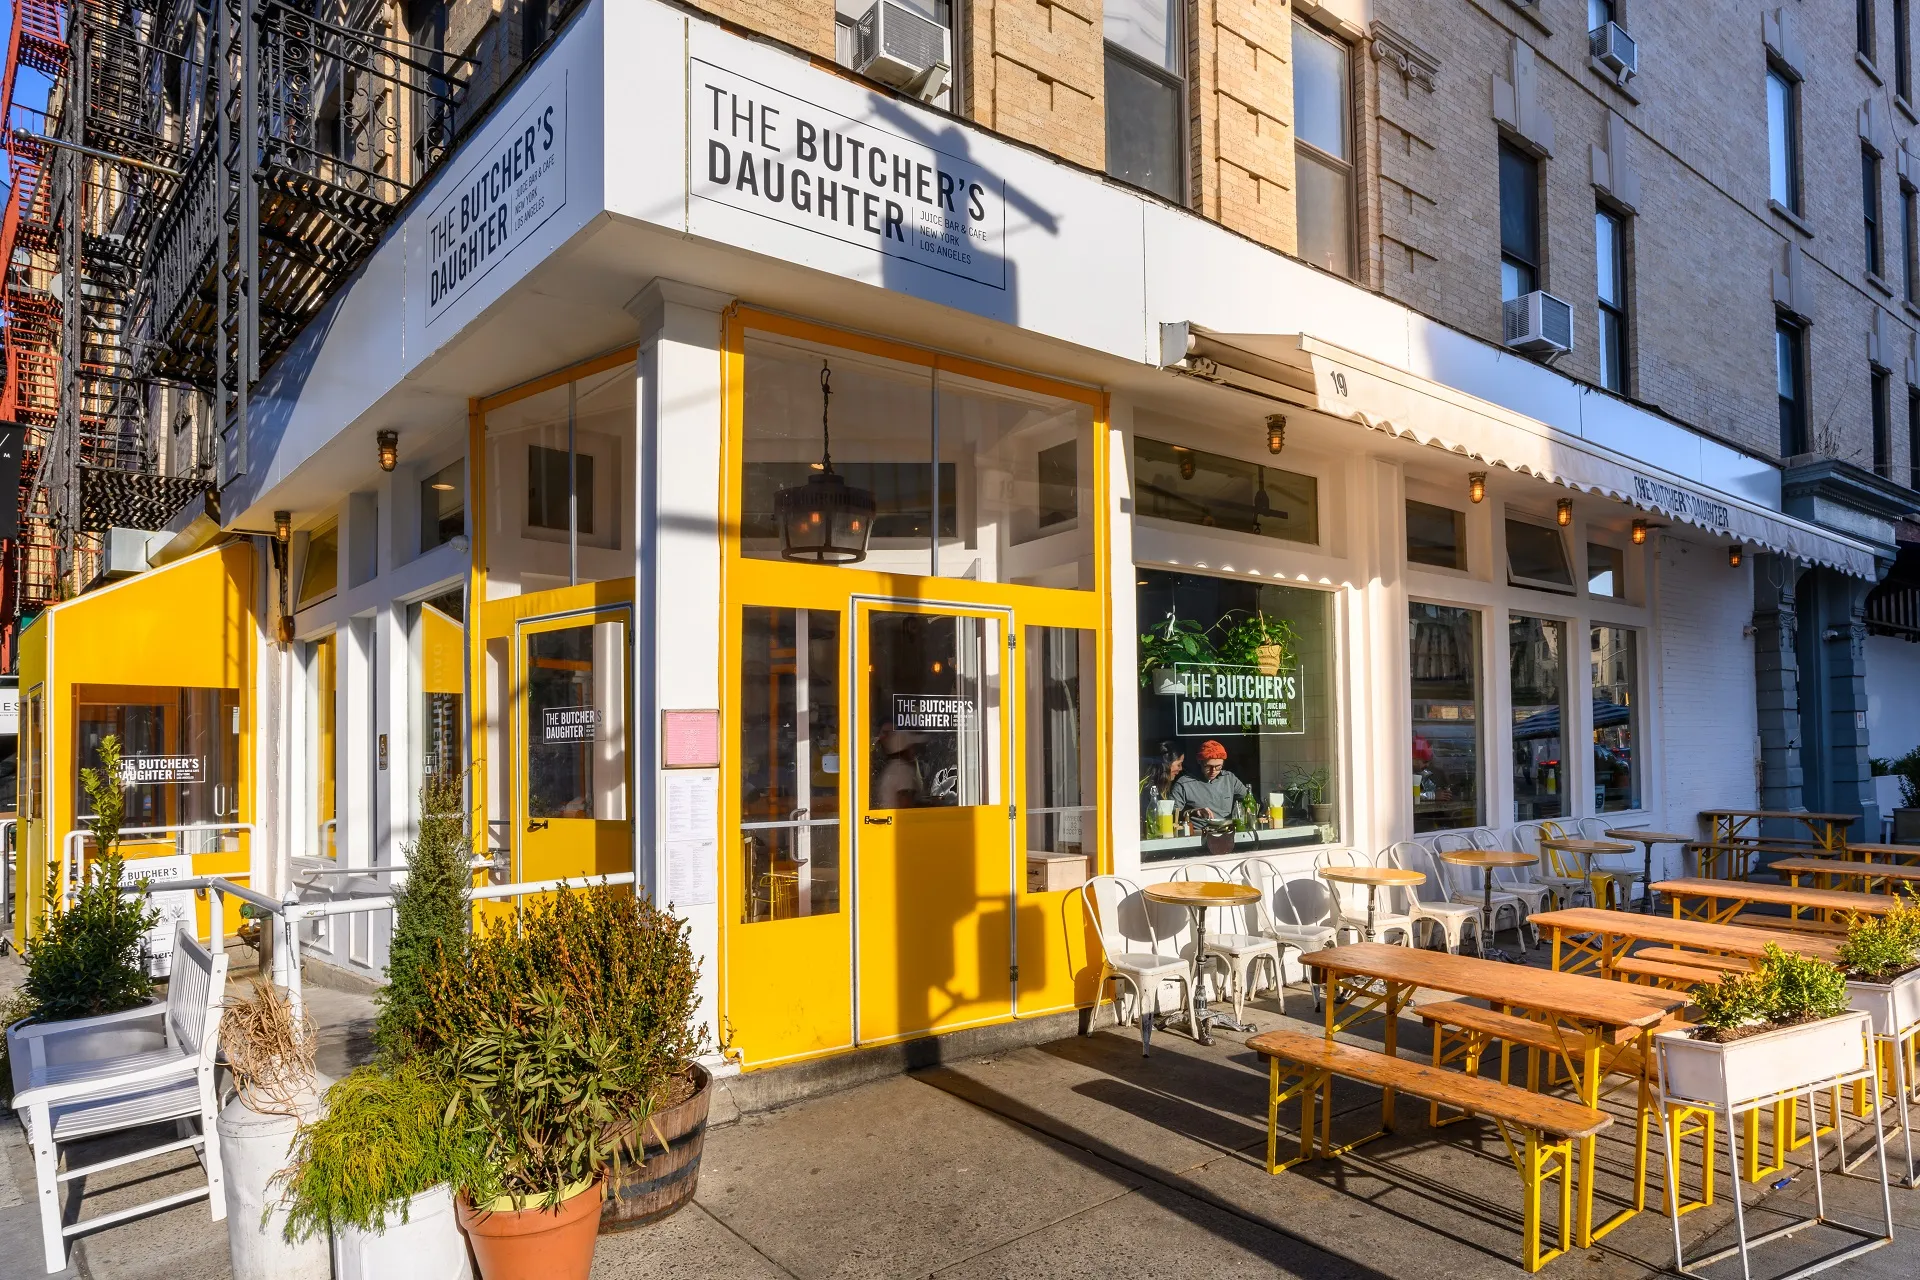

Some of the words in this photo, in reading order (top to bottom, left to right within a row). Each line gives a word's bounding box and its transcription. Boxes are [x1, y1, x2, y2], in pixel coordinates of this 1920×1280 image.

[705, 83, 780, 152] THE
[796, 118, 986, 222] BUTCHER'S
[430, 205, 456, 263] THE
[461, 105, 554, 235] BUTCHER'S
[515, 180, 528, 200] JUICE
[528, 170, 538, 187] BAR
[542, 153, 555, 173] CAFE
[515, 198, 526, 216] NEW
[526, 186, 538, 205] YORK
[708, 138, 905, 243] DAUGHTER
[515, 215, 524, 232] LOS
[523, 196, 545, 224] ANGELES
[920, 210, 943, 226] JUICE
[944, 218, 960, 232] BAR
[960, 224, 967, 234] &
[968, 226, 987, 241] CAFE
[920, 225, 938, 239] NEW
[939, 232, 960, 247] YORK
[431, 202, 508, 308] DAUGHTER
[920, 239, 935, 253] LOS
[936, 245, 972, 265] ANGELES
[1330, 370, 1348, 398] 19
[1633, 475, 1653, 500] THE
[1650, 481, 1692, 513] BUTCHER'S
[1691, 496, 1729, 528] DAUGHTER
[1181, 673, 1212, 698] THE
[1216, 674, 1296, 700] BUTCHER'S
[545, 712, 560, 726] THE
[560, 709, 602, 725] BUTCHERS
[897, 699, 917, 713] THE
[920, 699, 974, 714] BUTCHER'S
[897, 713, 950, 727] DAUGHTER
[1183, 701, 1262, 726] DAUGHTER
[546, 724, 584, 739] DAUGHTER
[139, 758, 199, 769] BUTCHER'S
[127, 867, 178, 881] BUTCHER'S
